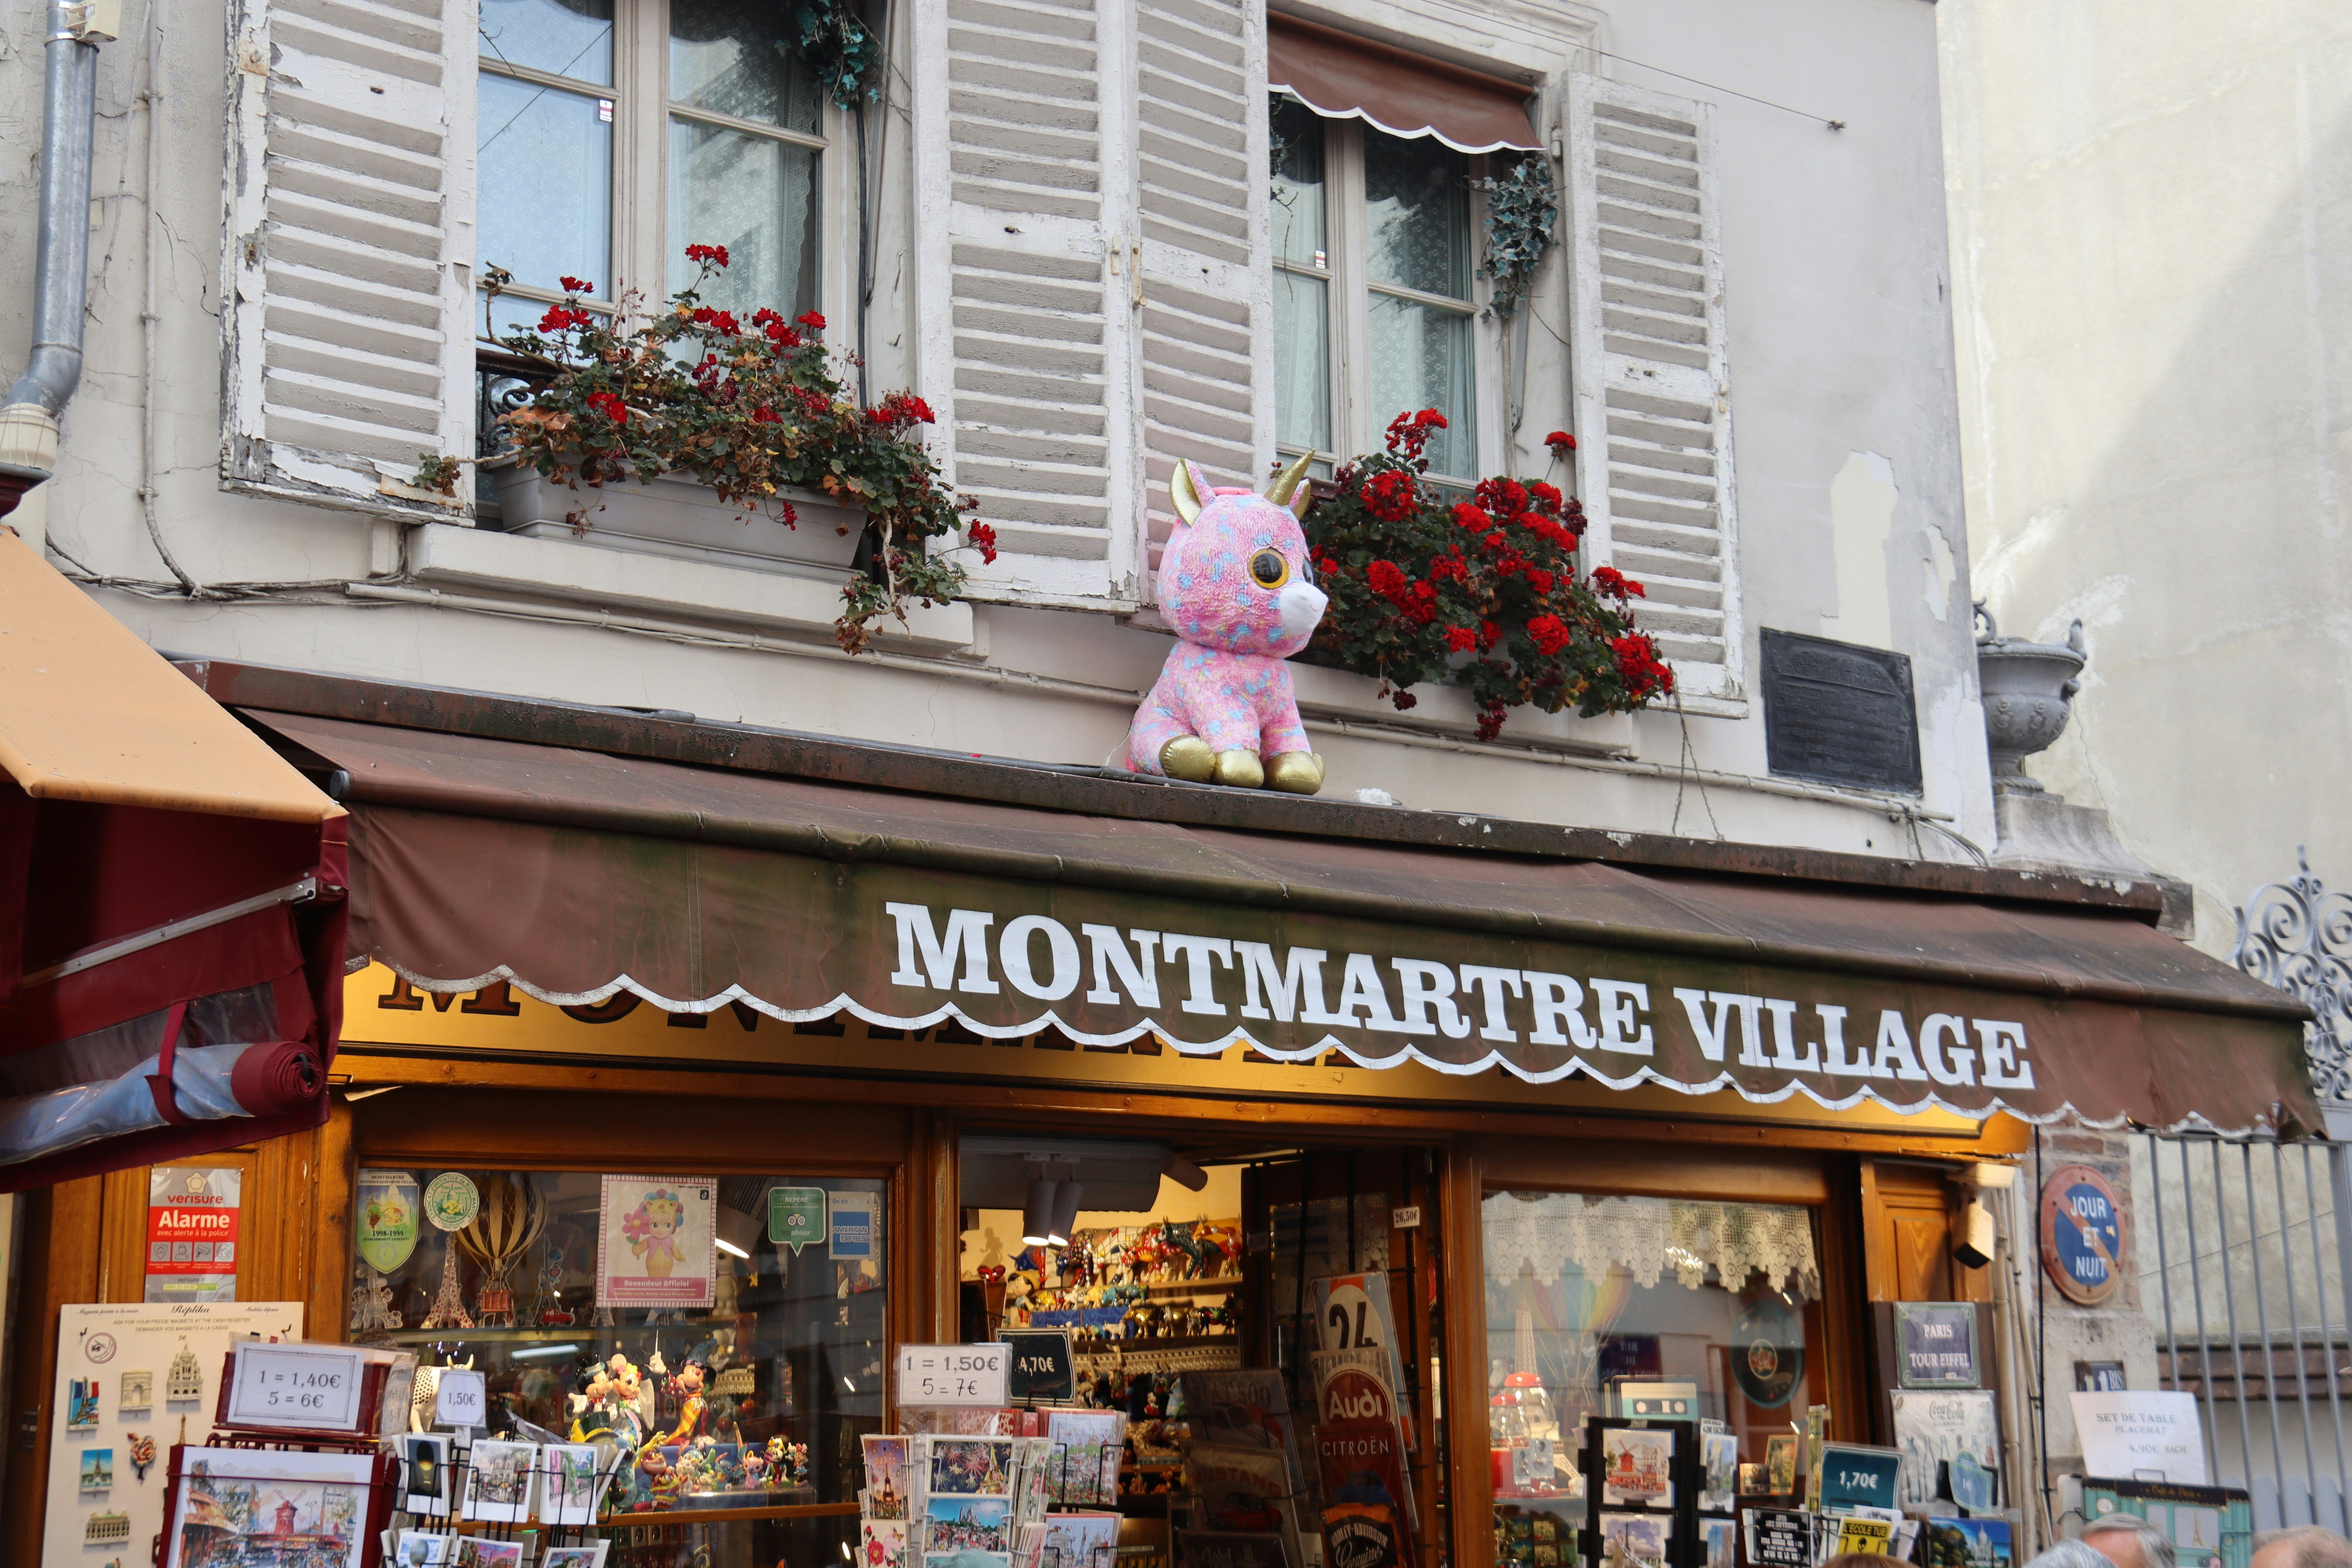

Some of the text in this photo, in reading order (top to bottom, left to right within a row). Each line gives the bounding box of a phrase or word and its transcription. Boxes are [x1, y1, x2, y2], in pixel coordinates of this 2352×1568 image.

[886, 902, 2035, 1089] MONTMARTRE VILLAGE
[167, 1195, 223, 1204] verisure
[2070, 1196, 2107, 1218] JOUR
[158, 1209, 230, 1228] Alarme
[1395, 1209, 1417, 1223] 26,50€
[2082, 1227, 2099, 1247] ET
[2076, 1256, 2106, 1277] NUIT
[171, 1304, 211, 1316] Réplika
[1924, 1324, 1953, 1338] PARIS
[906, 1356, 912, 1370] 1
[944, 1356, 999, 1373] 1,50€
[1020, 1356, 1055, 1377] 4,70€
[1909, 1352, 1969, 1367] TOUR EIFFEL
[260, 1370, 266, 1383] 1
[292, 1372, 341, 1388] 1,40€
[923, 1378, 934, 1395] 5
[956, 1378, 978, 1396] 7€
[268, 1391, 279, 1405] 5
[301, 1393, 324, 1408] 6€
[448, 1392, 475, 1406] 1,50€
[1329, 1388, 1383, 1419] Audi
[2096, 1413, 2176, 1423] SET DE TABLE
[2115, 1425, 2167, 1434] PLACEMAT
[1322, 1435, 1389, 1456] CITROËN
[2164, 1445, 2187, 1454] EACH
[1839, 1470, 1878, 1490] 1,70€
[1330, 1523, 1388, 1548] HARLEY-DAVIDSON
[1873, 1526, 1887, 1536] TUE
